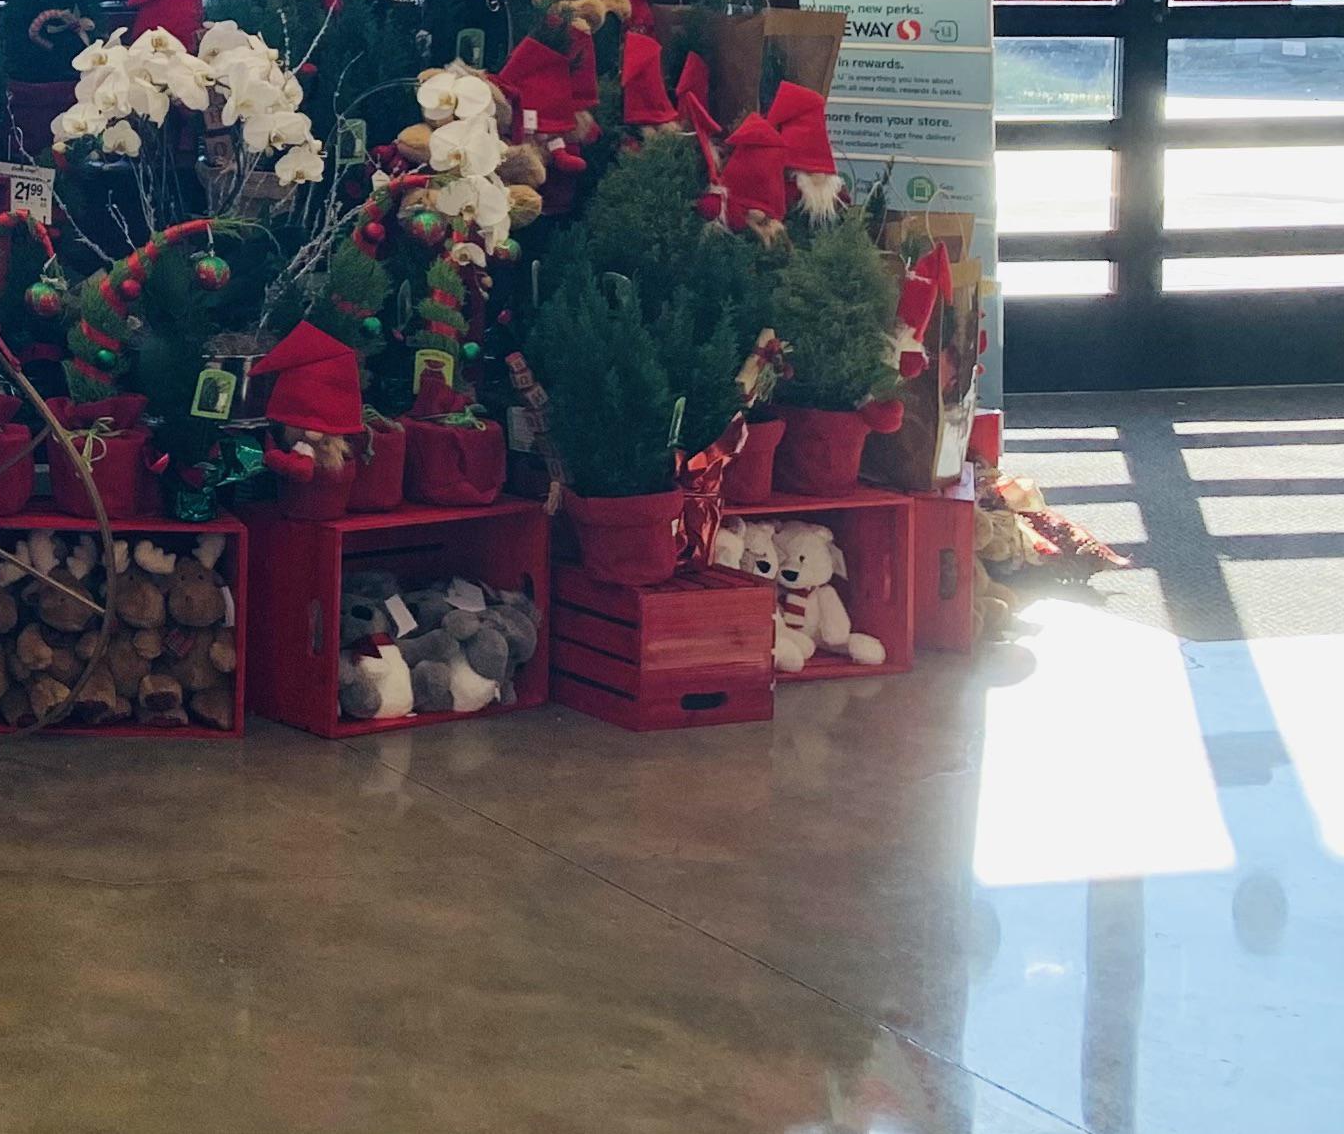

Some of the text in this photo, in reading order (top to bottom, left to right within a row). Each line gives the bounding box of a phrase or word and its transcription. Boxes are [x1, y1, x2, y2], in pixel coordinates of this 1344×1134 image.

[858, 4, 883, 14] new
[838, 58, 905, 70] in rewards.
[856, 75, 896, 85] everything
[898, 77, 913, 85] you
[932, 76, 954, 84] about
[899, 86, 930, 95] rewards
[855, 112, 883, 124] from
[887, 116, 914, 128] your
[917, 116, 953, 128] store.
[894, 132, 907, 141] get
